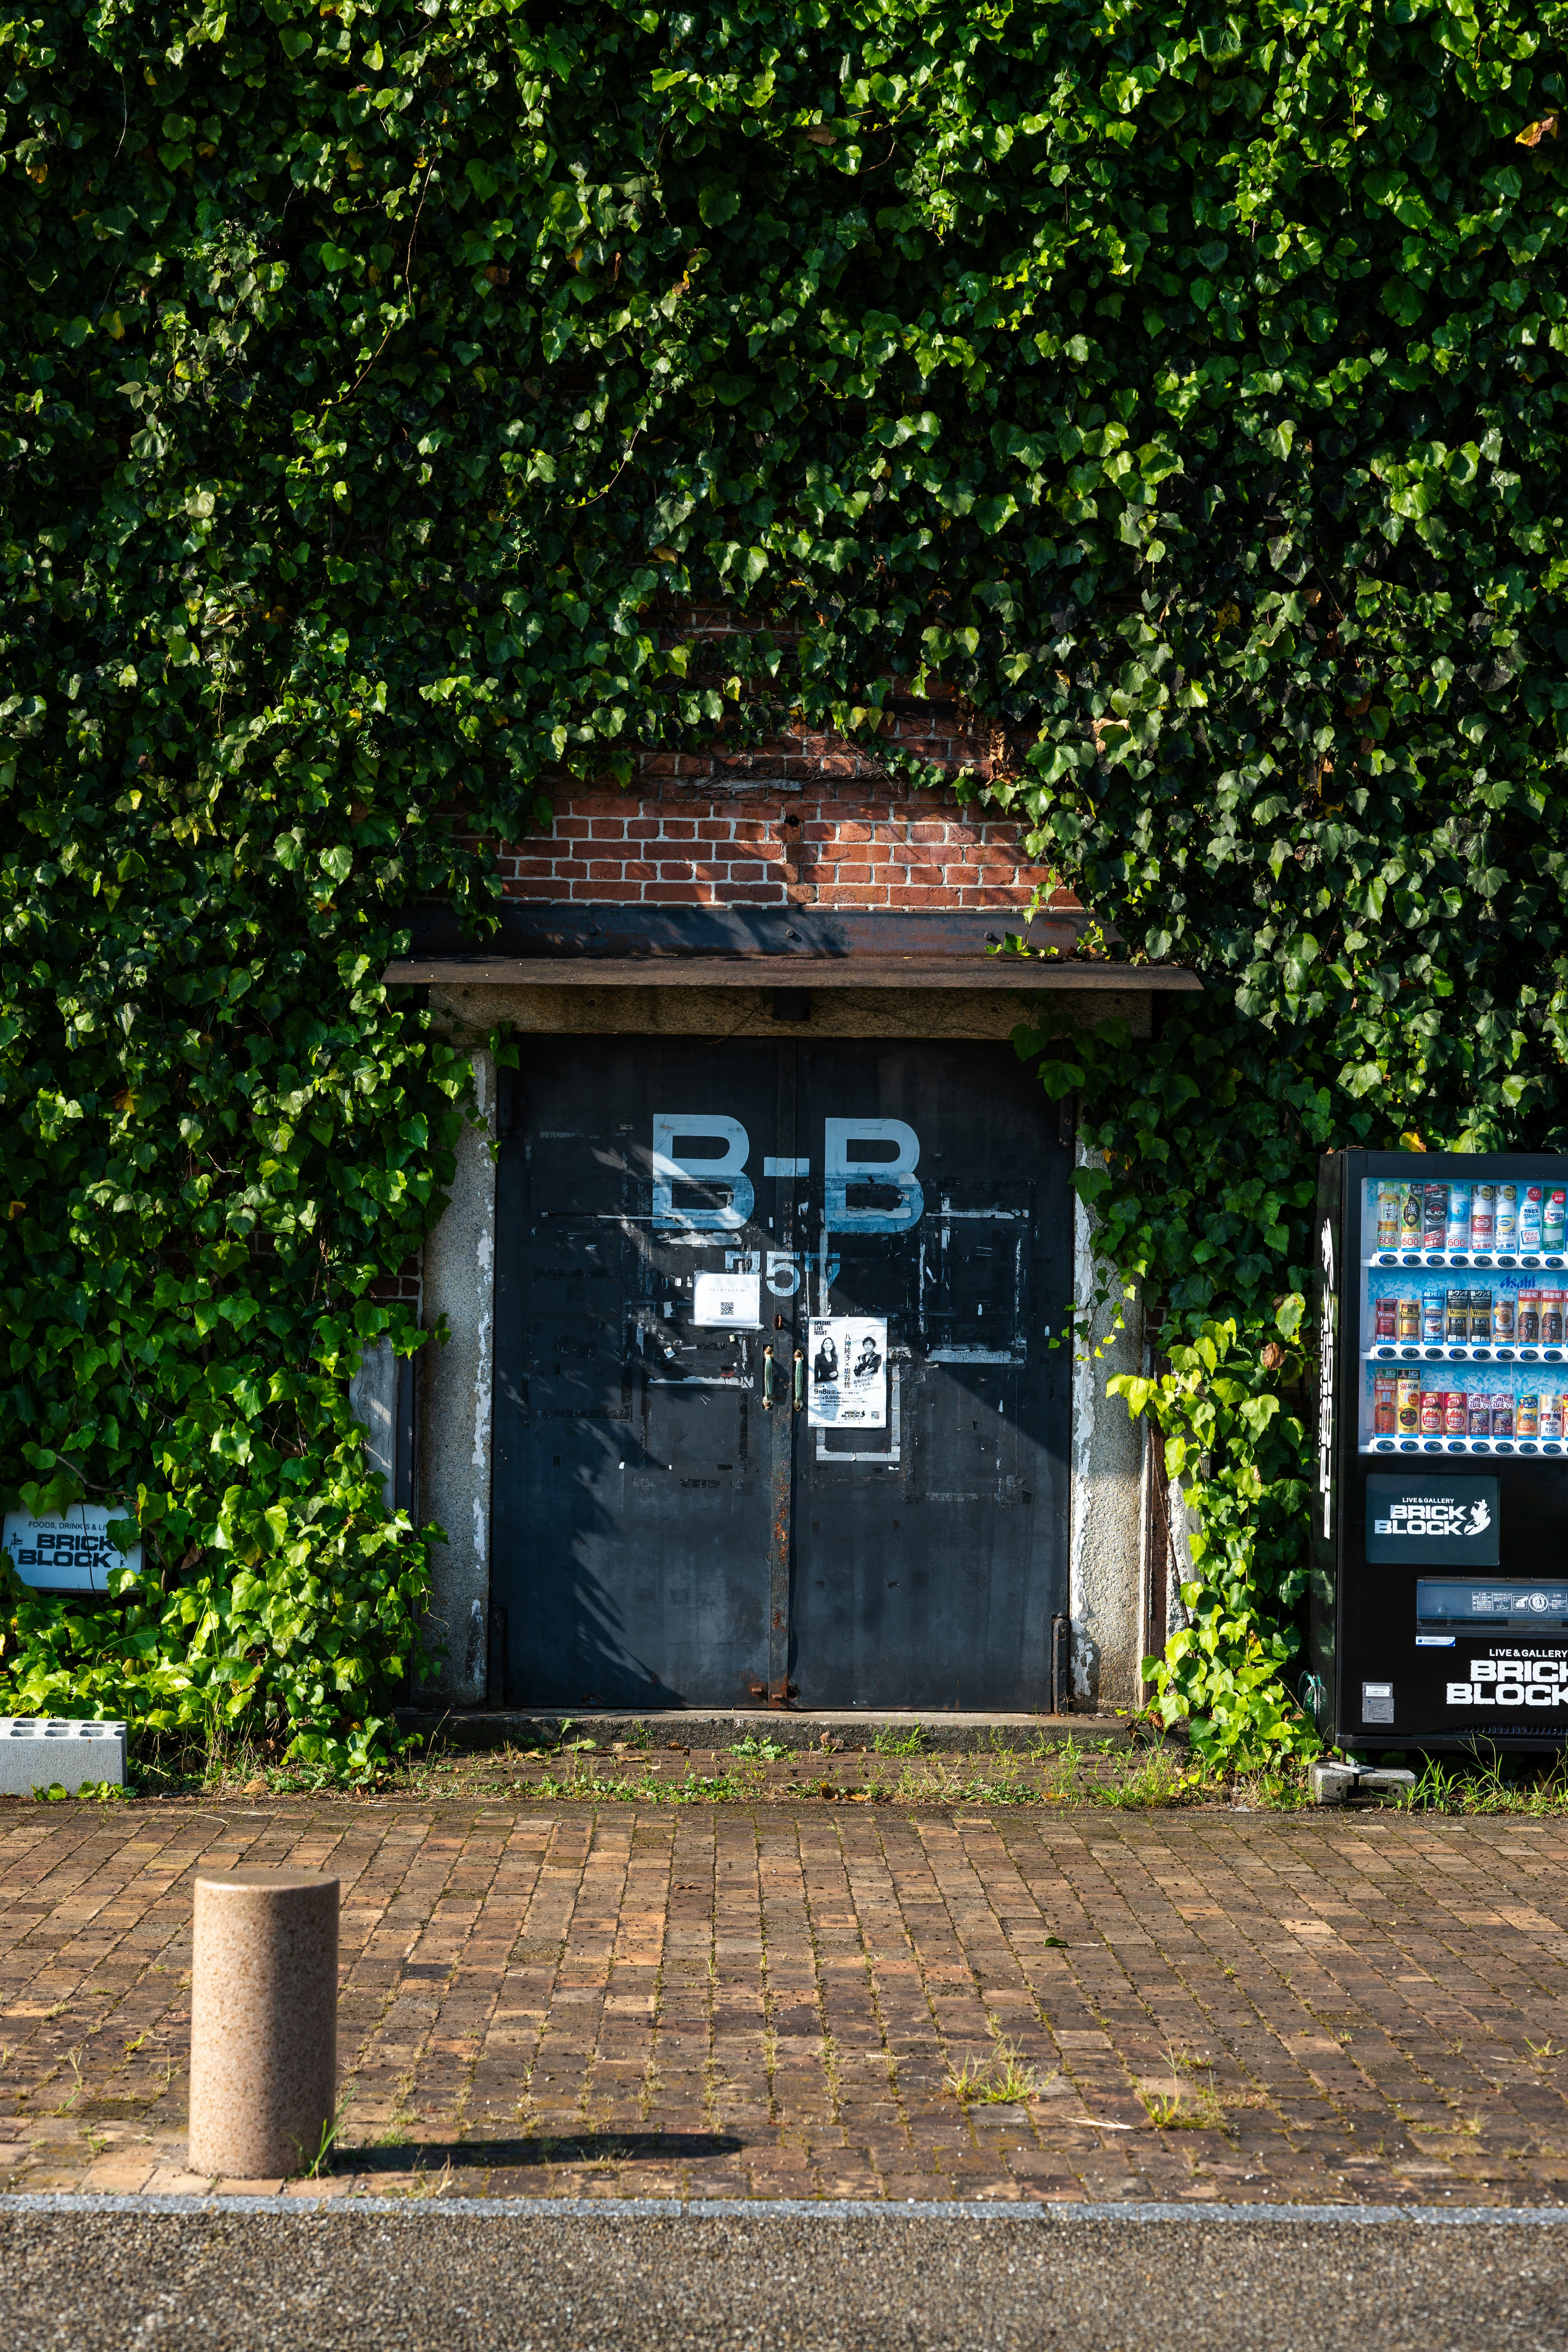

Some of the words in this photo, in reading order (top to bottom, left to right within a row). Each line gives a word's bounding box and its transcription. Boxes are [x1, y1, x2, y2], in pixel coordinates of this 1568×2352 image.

[652, 1113, 924, 1233] B-B
[1379, 1236, 1395, 1244] 600
[1448, 1239, 1465, 1247] 600
[1500, 1275, 1536, 1289] Asahi
[853, 1376, 874, 1384] 音楽のレシピ
[1319, 1283, 1329, 1494] BRICK
[1400, 1382, 1419, 1390] 強炭酸
[1470, 1397, 1489, 1408] 濃い
[1493, 1397, 1513, 1409] 濃い
[1324, 1297, 1334, 1540] BLOCK
[1471, 1419, 1482, 1427] 濃い
[1494, 1419, 1505, 1428] 濃い
[1390, 1505, 1467, 1520] BRICK
[28, 1521, 57, 1530] FOODS,
[1374, 1520, 1463, 1535] BLOCK
[36, 1533, 118, 1552] BRICK
[18, 1549, 113, 1568] BLOCK
[1489, 1648, 1512, 1657] LIVE
[1522, 1649, 1568, 1657] GALLERY
